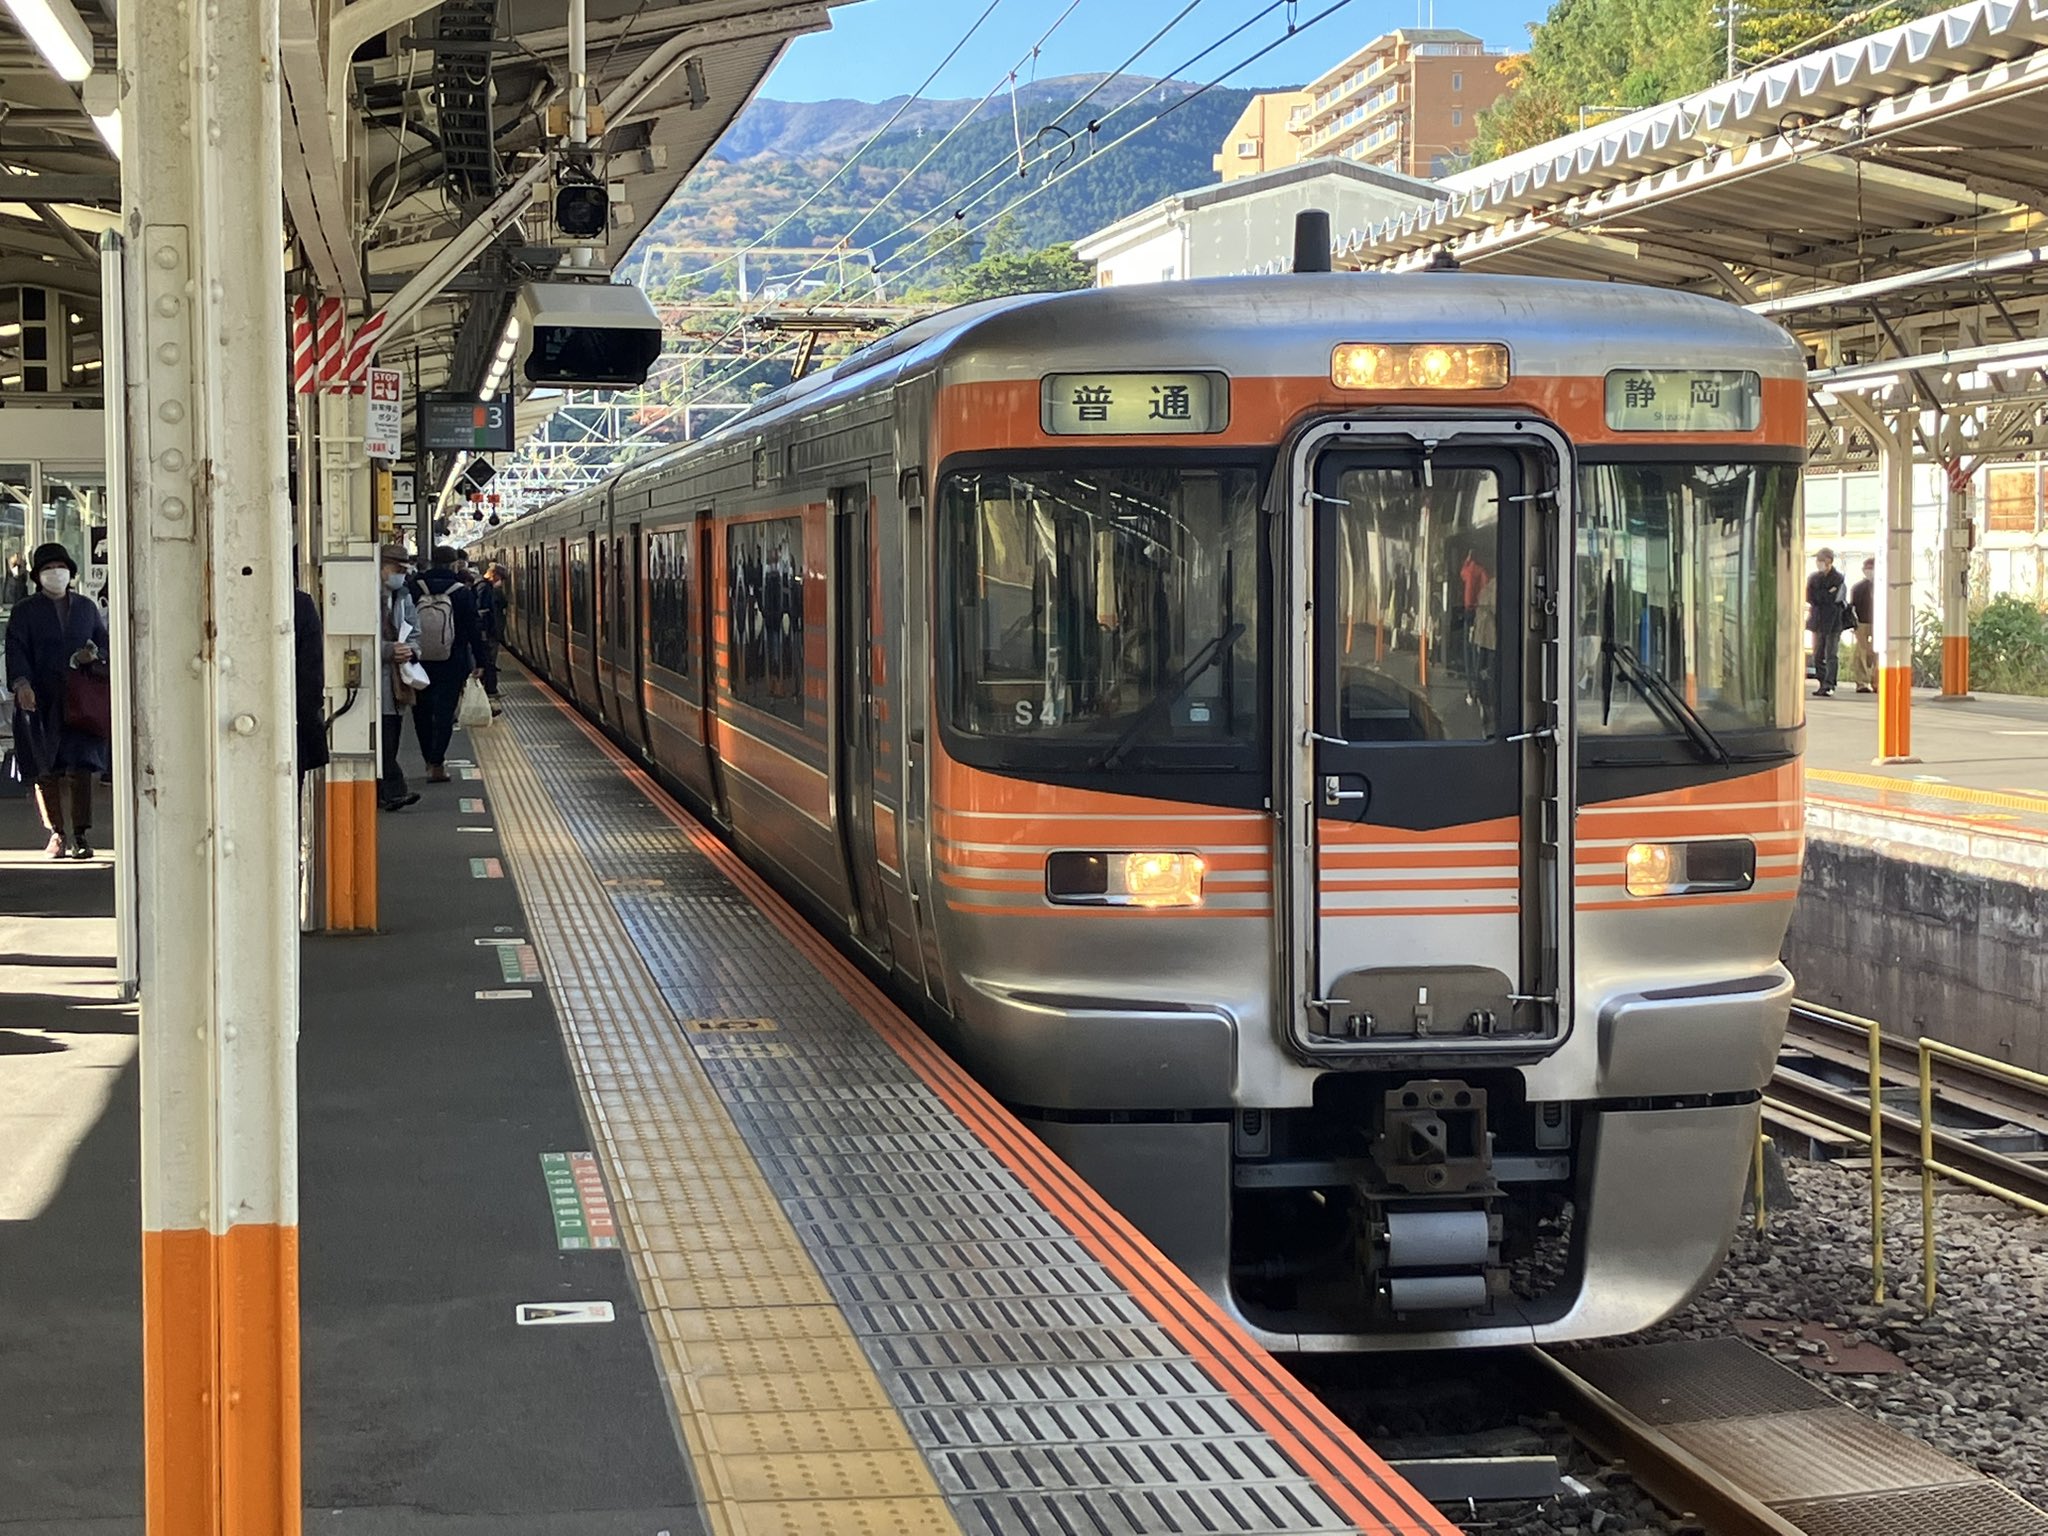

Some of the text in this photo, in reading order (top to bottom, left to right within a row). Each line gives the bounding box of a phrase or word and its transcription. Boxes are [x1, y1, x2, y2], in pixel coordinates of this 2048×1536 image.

[374, 372, 399, 382] STOP
[1072, 385, 1191, 421] 普通
[1625, 378, 1720, 408] 静岡
[488, 406, 503, 429] 3
[1015, 700, 1057, 726] S 4
